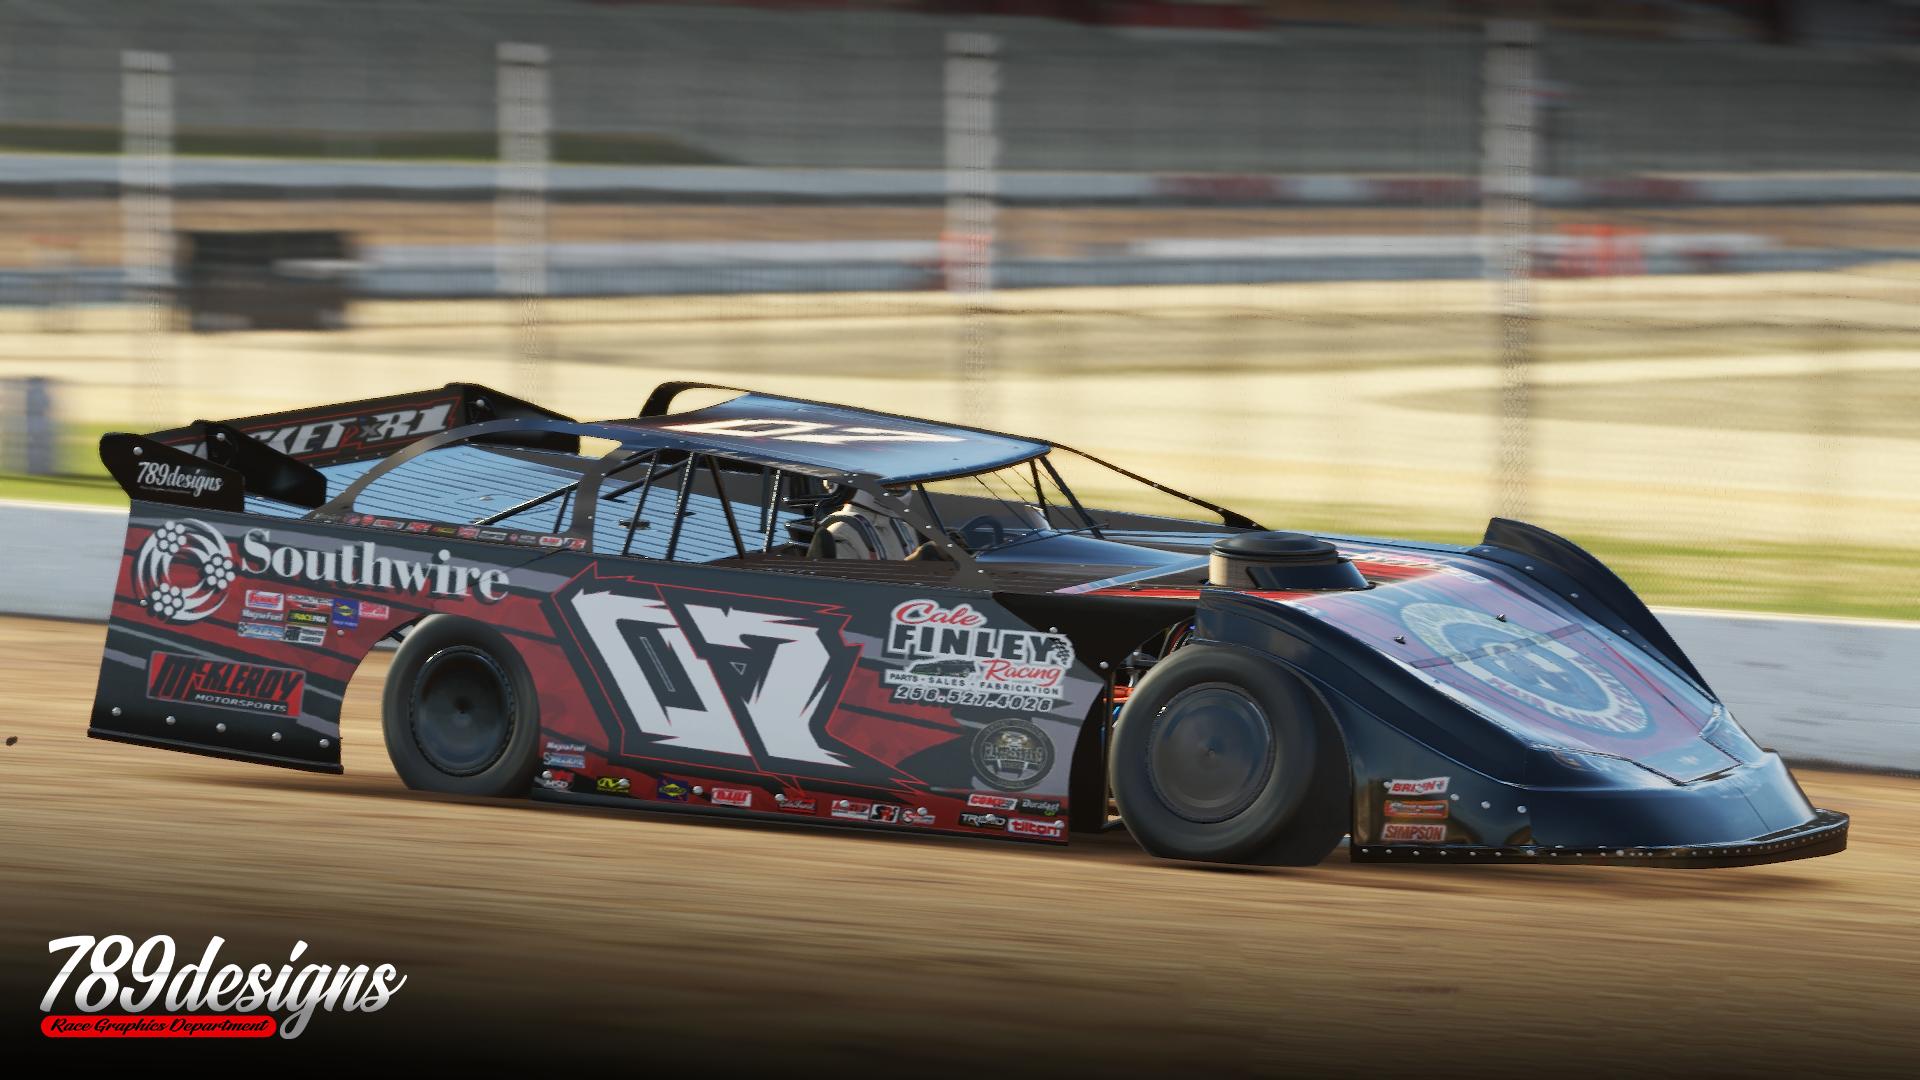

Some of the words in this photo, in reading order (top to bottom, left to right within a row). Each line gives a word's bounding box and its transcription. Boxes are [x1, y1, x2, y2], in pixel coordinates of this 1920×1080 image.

[137, 461, 224, 497] 789designs
[241, 527, 510, 601] Southwire
[896, 602, 982, 626] Cale
[892, 623, 1053, 662] FINLEY
[889, 672, 918, 683] PARTS
[929, 676, 966, 687] SALES
[979, 681, 1060, 696] FABRICATION
[981, 659, 1063, 688] Racing
[194, 693, 288, 712] MOTORSPORTS
[1385, 825, 1444, 840] SIMPSON
